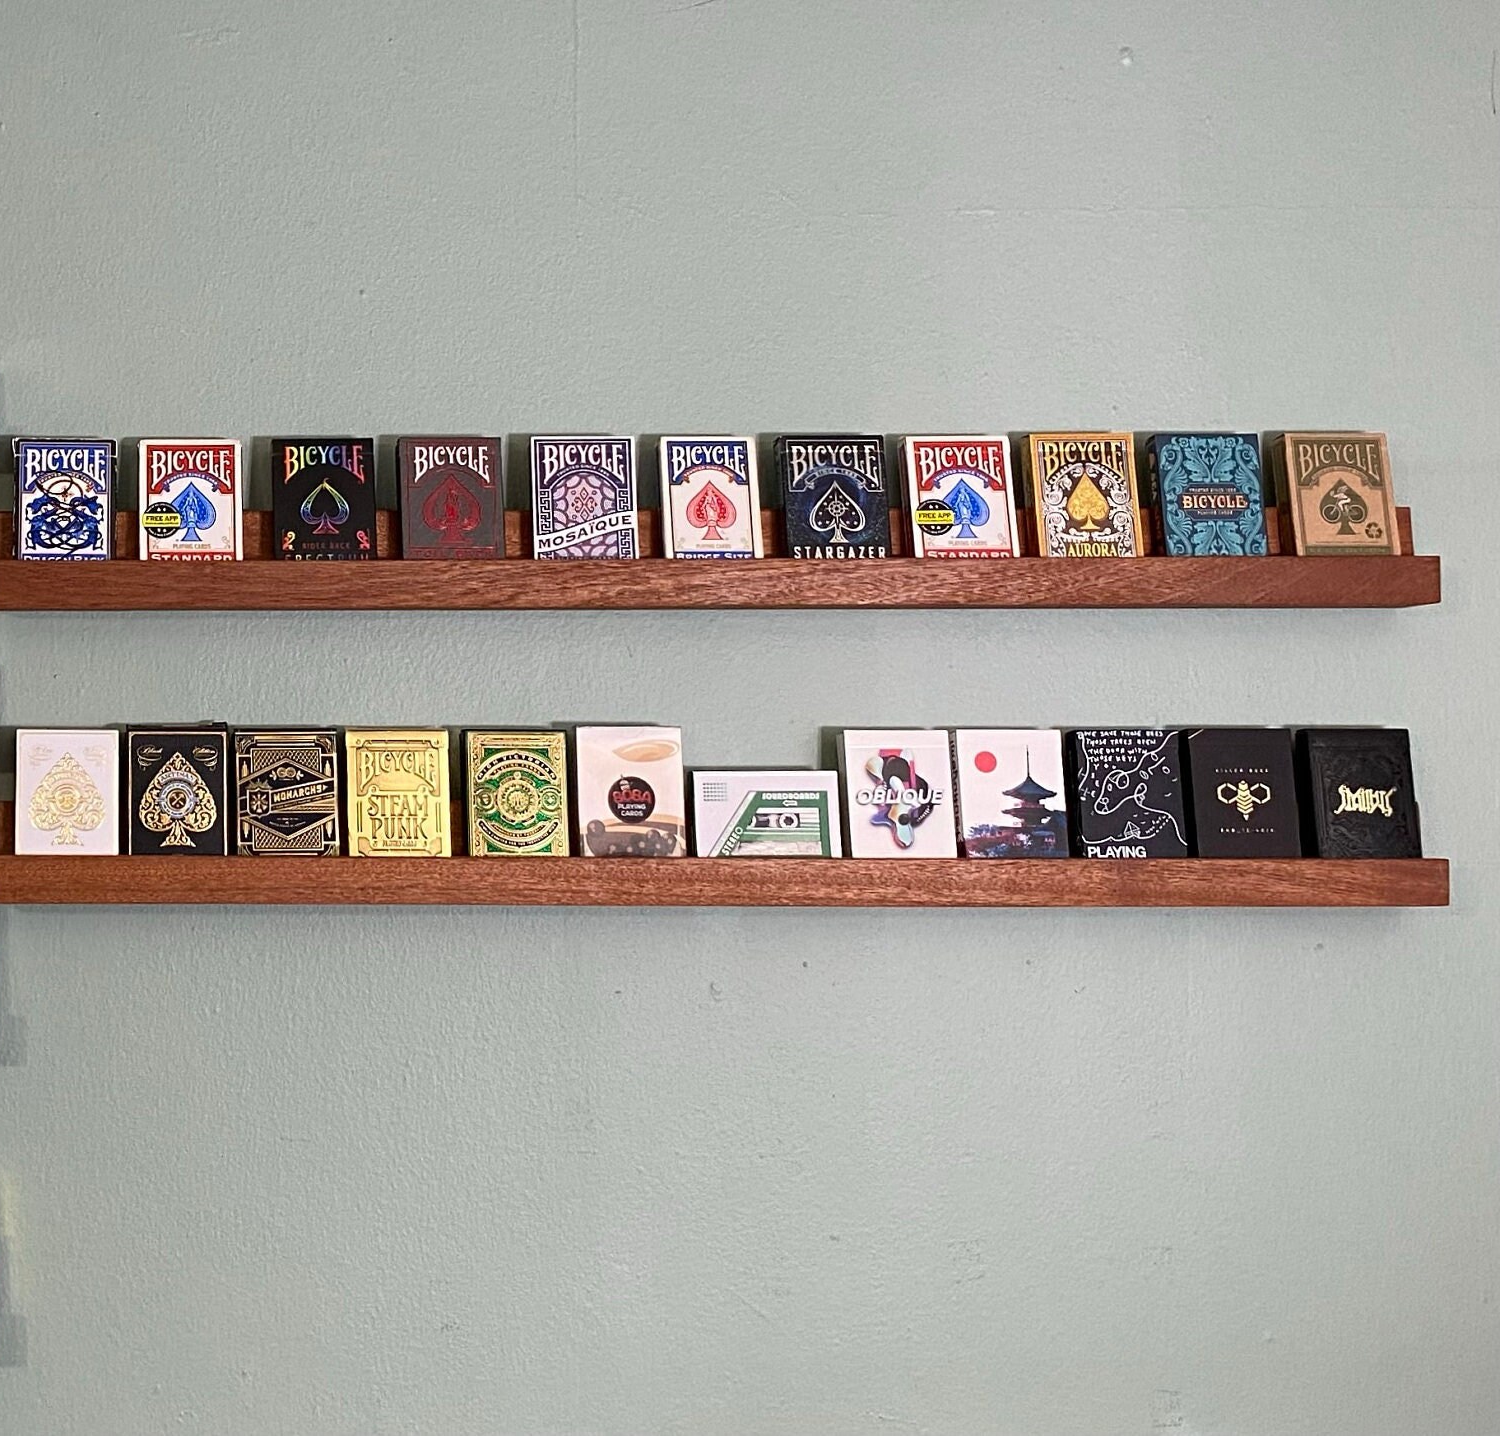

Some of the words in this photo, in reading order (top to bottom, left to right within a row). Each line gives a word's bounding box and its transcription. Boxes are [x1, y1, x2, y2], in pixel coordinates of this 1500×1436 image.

[25, 448, 106, 490] BICYCLE
[151, 450, 232, 490] BICYCLE
[284, 445, 365, 485] BICYCLE
[414, 446, 490, 484] BICYCLE
[541, 444, 625, 485] BICYCLE
[671, 445, 747, 482] BICYCLE
[790, 445, 878, 488] BICYCLE
[920, 446, 1002, 487] BICYCLE
[1044, 441, 1125, 481] BICYCLE
[1298, 443, 1380, 482] BICYCLE
[1182, 495, 1248, 509] BICYCLE
[538, 515, 632, 549] MOSAÏQUE
[793, 546, 886, 559] STARGAZER
[1068, 543, 1118, 557] AURORA
[359, 751, 436, 793] BICYCLE
[273, 784, 322, 803] MONARCHS
[367, 794, 429, 817] STEAM
[612, 788, 652, 804] BOBA
[856, 788, 944, 807] OBLIQUE
[369, 817, 428, 840] PUNK
[721, 826, 743, 856] STEREO
[1087, 846, 1147, 858] PLAYING
